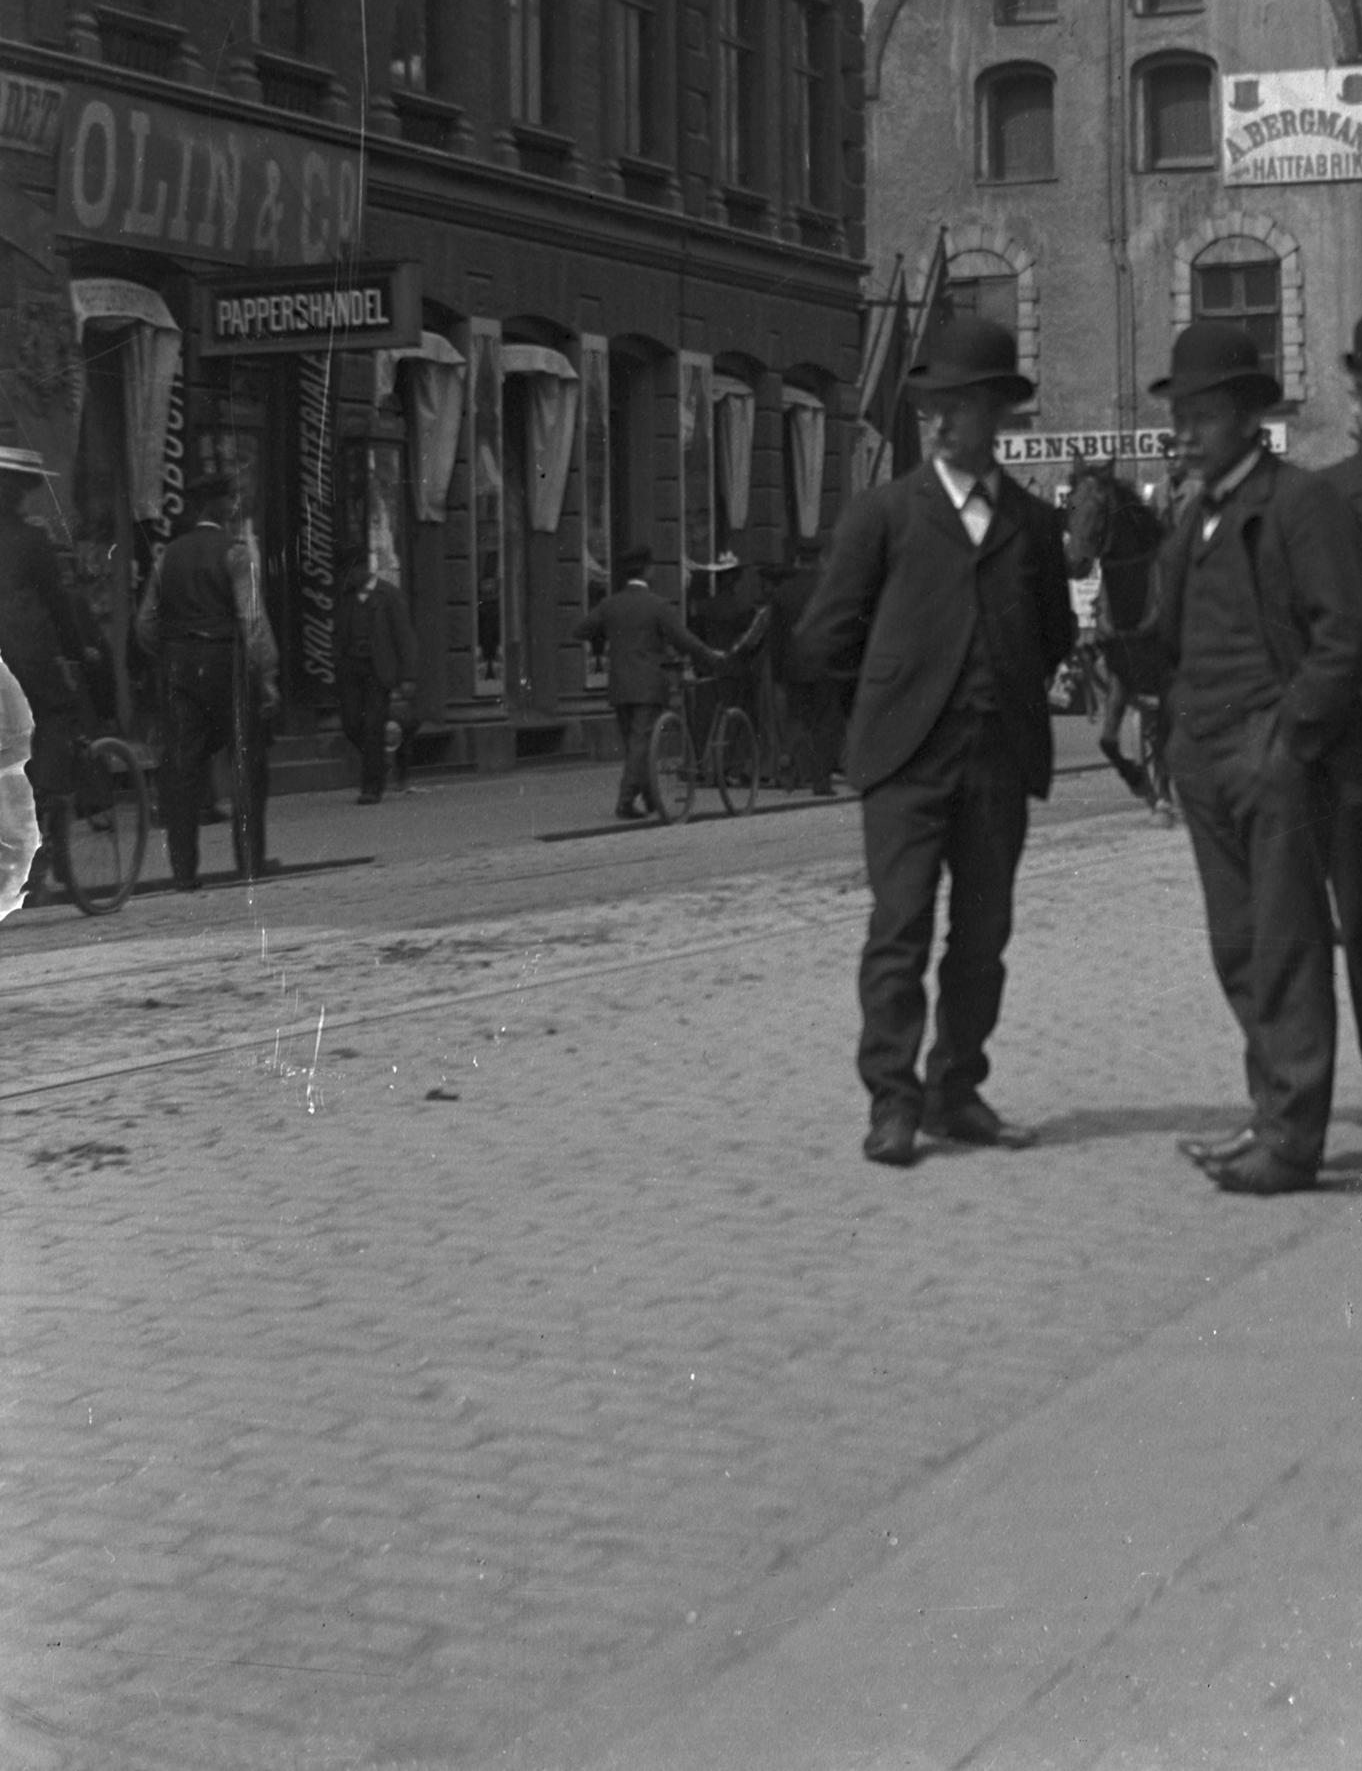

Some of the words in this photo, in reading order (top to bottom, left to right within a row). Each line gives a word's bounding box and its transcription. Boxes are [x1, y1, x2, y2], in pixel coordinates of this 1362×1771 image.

[72, 99, 242, 250] OLIN
[254, 158, 284, 260] &
[216, 288, 390, 336] PAPPERSHANDEL
[993, 431, 1173, 460] LENSBURGS
